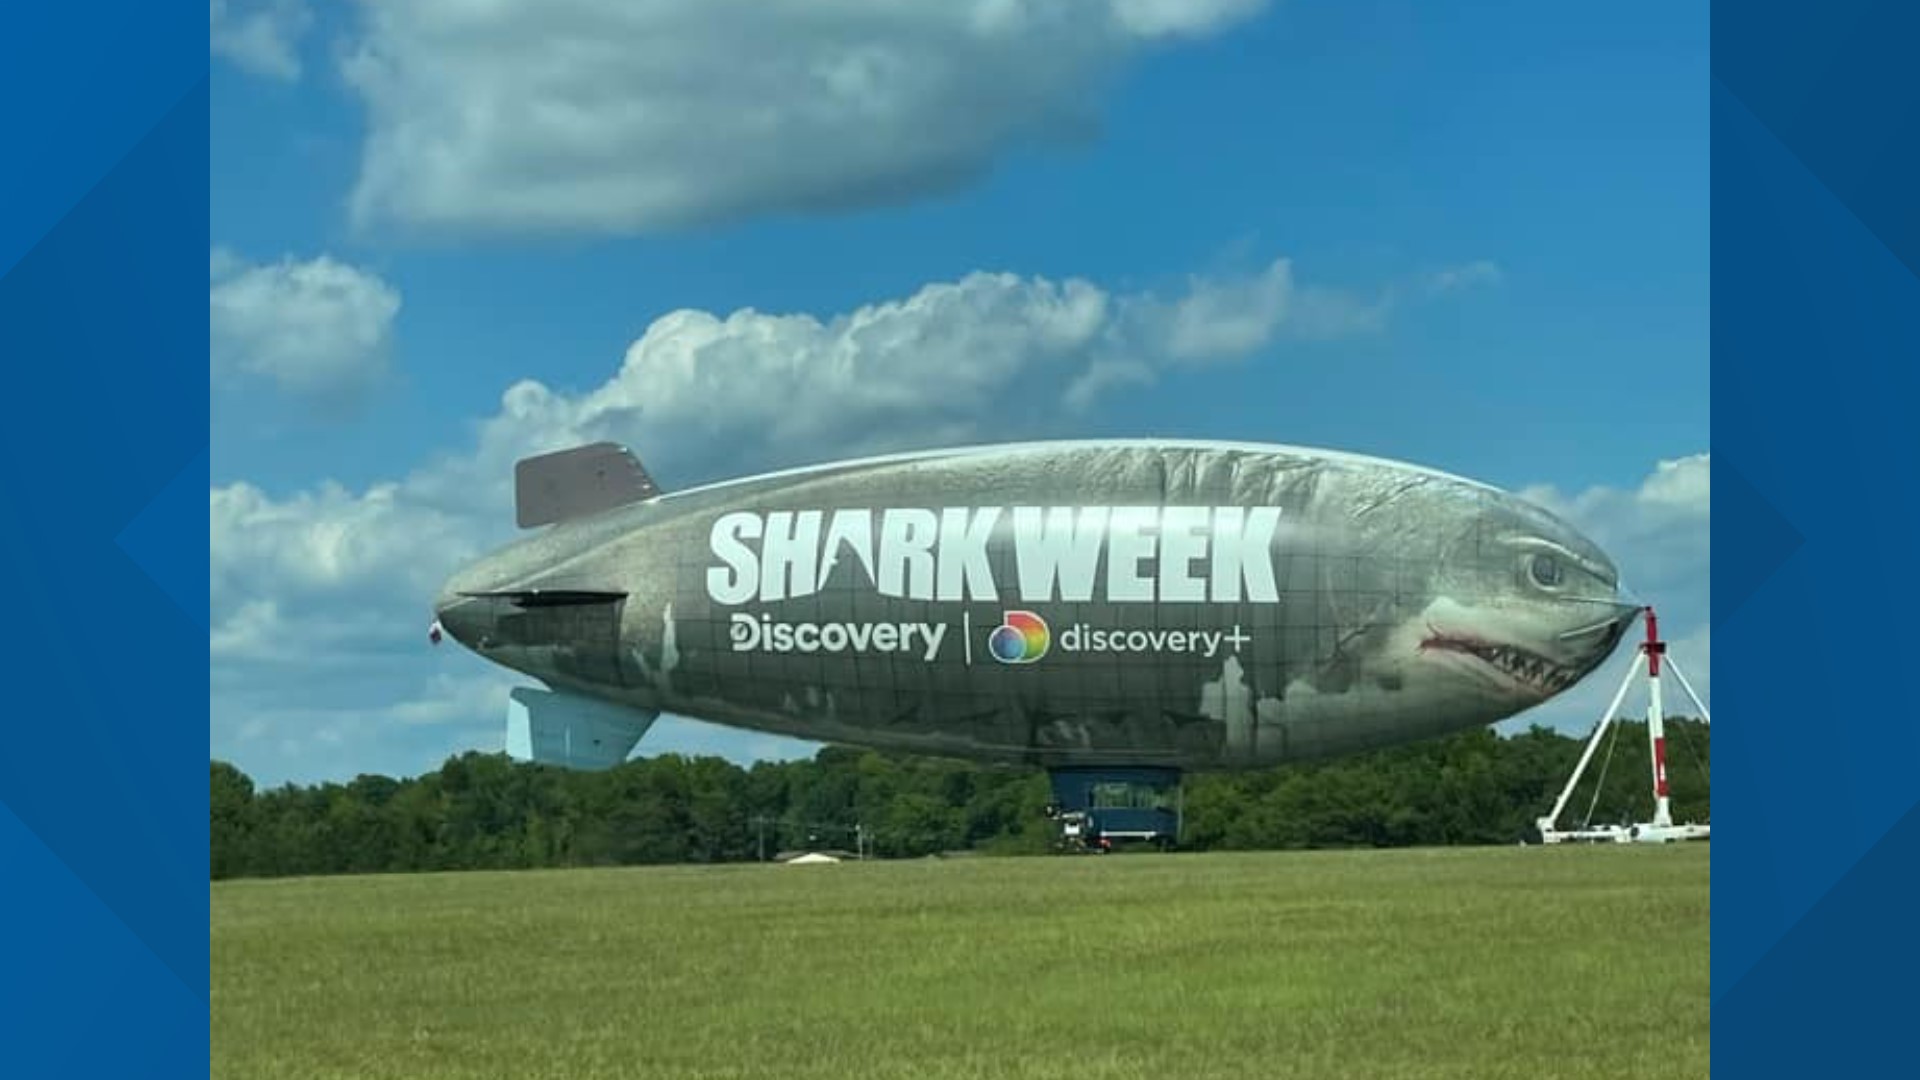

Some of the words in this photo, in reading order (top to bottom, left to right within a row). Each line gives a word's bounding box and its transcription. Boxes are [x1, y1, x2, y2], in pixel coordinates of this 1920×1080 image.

[706, 506, 999, 605] SHARK
[1013, 506, 1282, 602] WEEK
[730, 612, 946, 661] Discovery
[1060, 622, 1251, 658] discovery+
